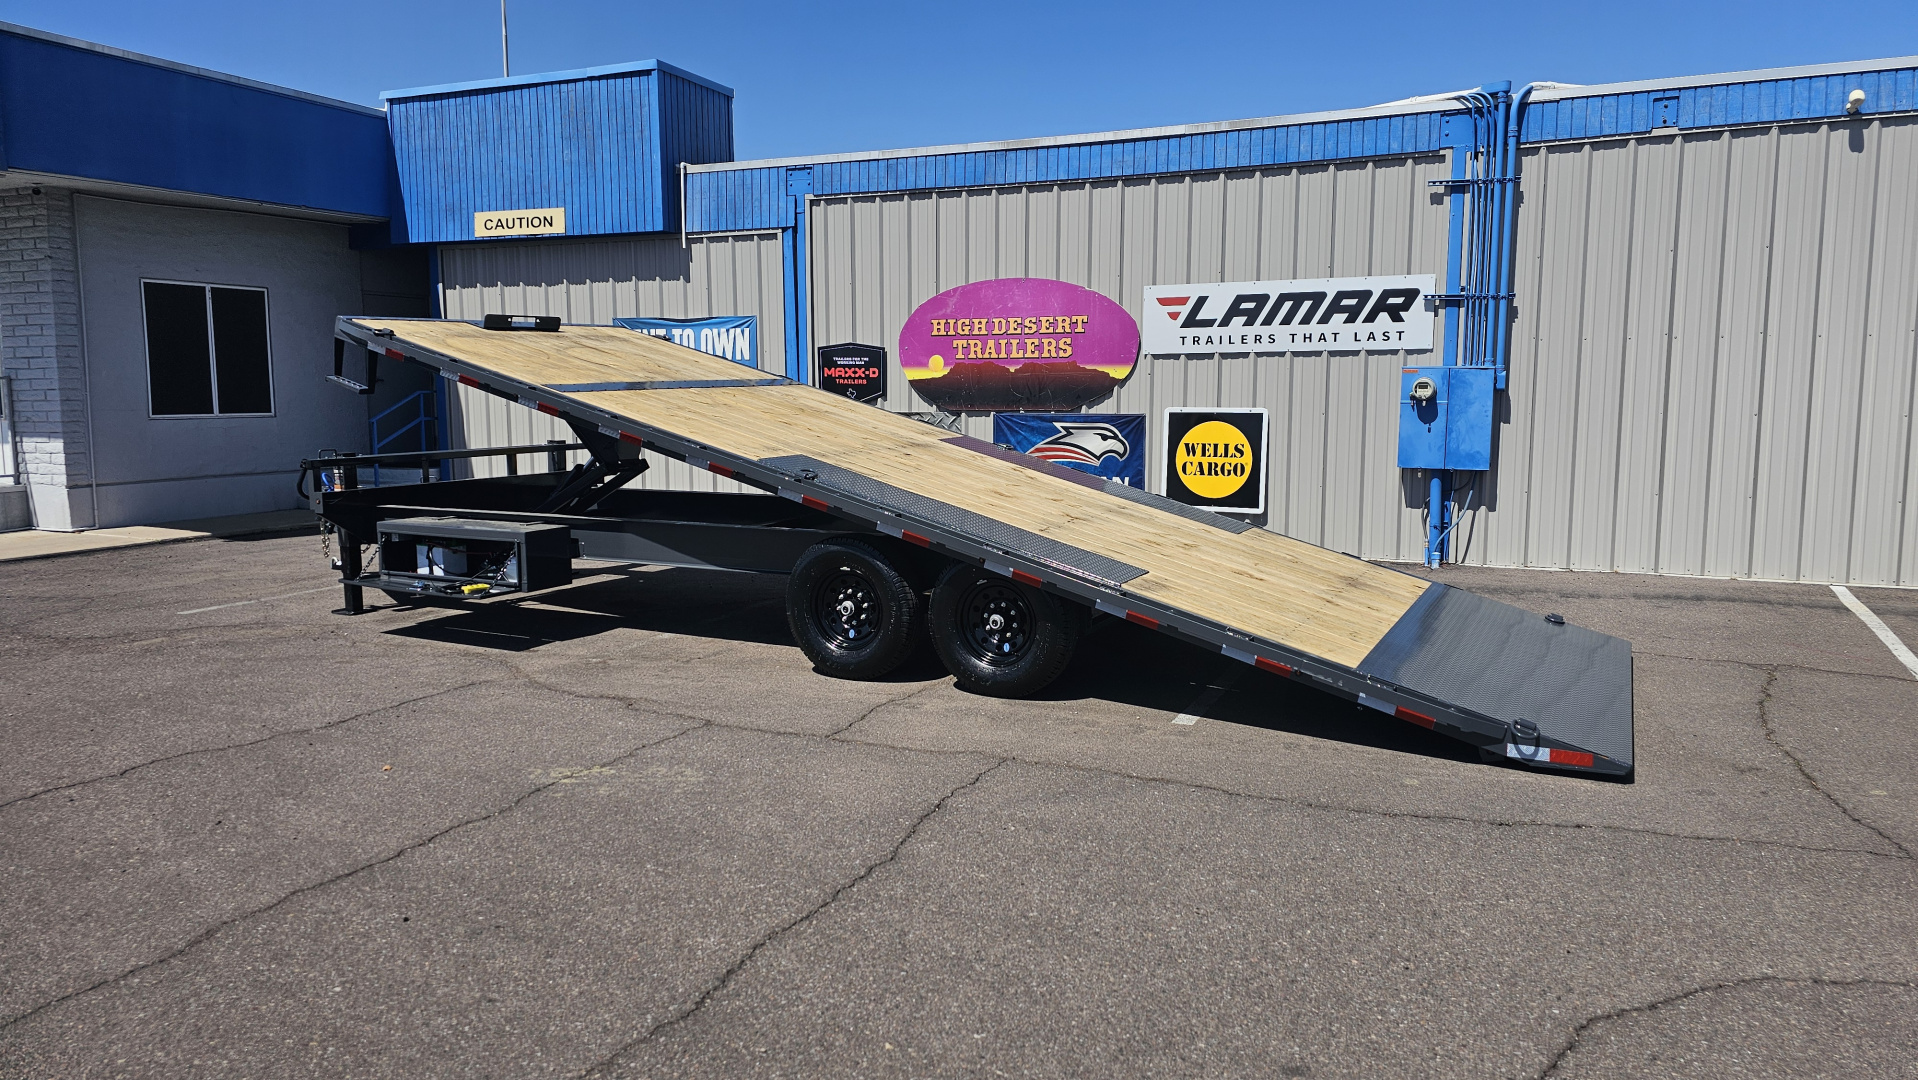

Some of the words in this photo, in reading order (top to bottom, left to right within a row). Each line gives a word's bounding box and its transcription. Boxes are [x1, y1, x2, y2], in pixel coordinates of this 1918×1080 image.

[484, 216, 553, 230] CAUTION
[1180, 288, 1421, 328] LAMAR
[931, 318, 989, 336] HIGH
[992, 315, 1088, 335] DESERT
[701, 327, 750, 360] OWN
[1180, 333, 1276, 346] TRAILERS
[1289, 332, 1340, 344] THAT
[1354, 330, 1405, 342] LAST
[952, 337, 1073, 360] TRAILERS
[824, 367, 879, 378] MAXX-D
[1184, 443, 1245, 458] WELLS
[1181, 461, 1246, 477] CARGO
